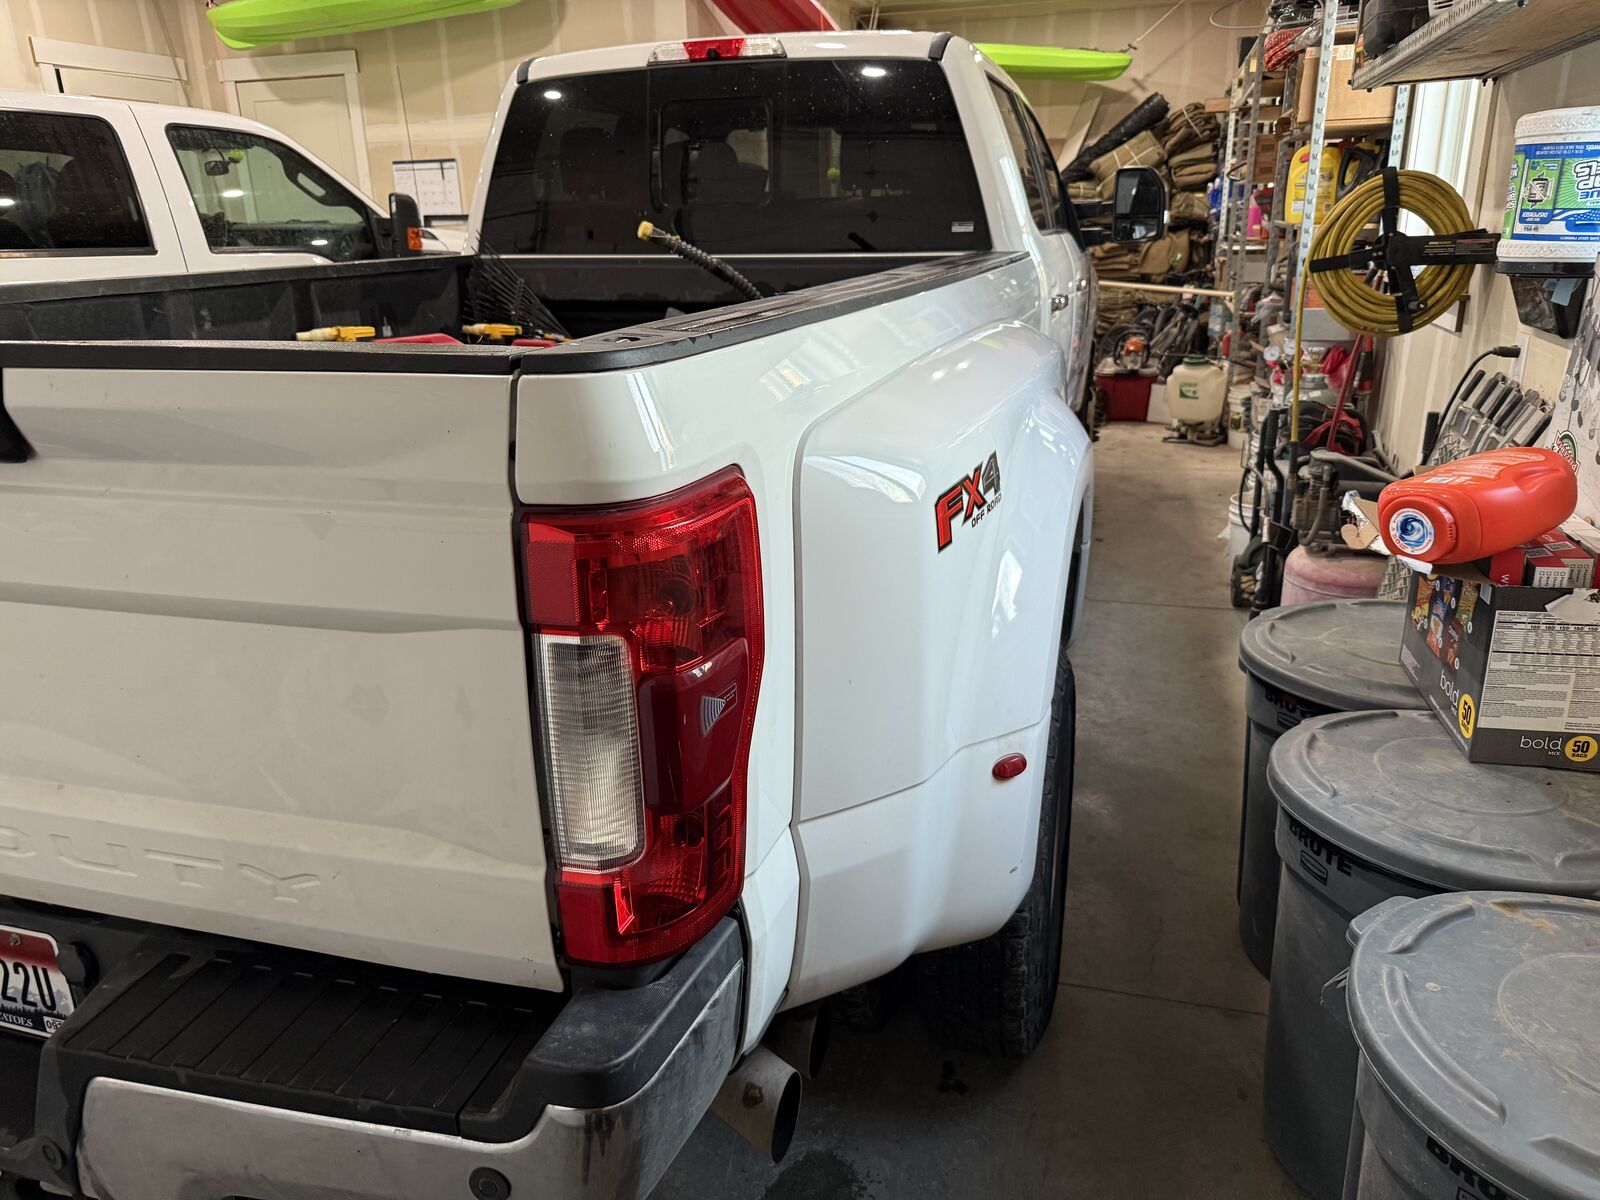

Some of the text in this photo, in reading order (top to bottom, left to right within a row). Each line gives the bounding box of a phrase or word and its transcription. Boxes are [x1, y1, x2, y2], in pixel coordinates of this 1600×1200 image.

[934, 450, 1001, 554] FX4
[971, 493, 1002, 528] OFF ROAD
[1439, 669, 1460, 708] bold
[1461, 700, 1472, 724] 50
[1519, 735, 1563, 751] bold
[1571, 740, 1590, 754] 50
